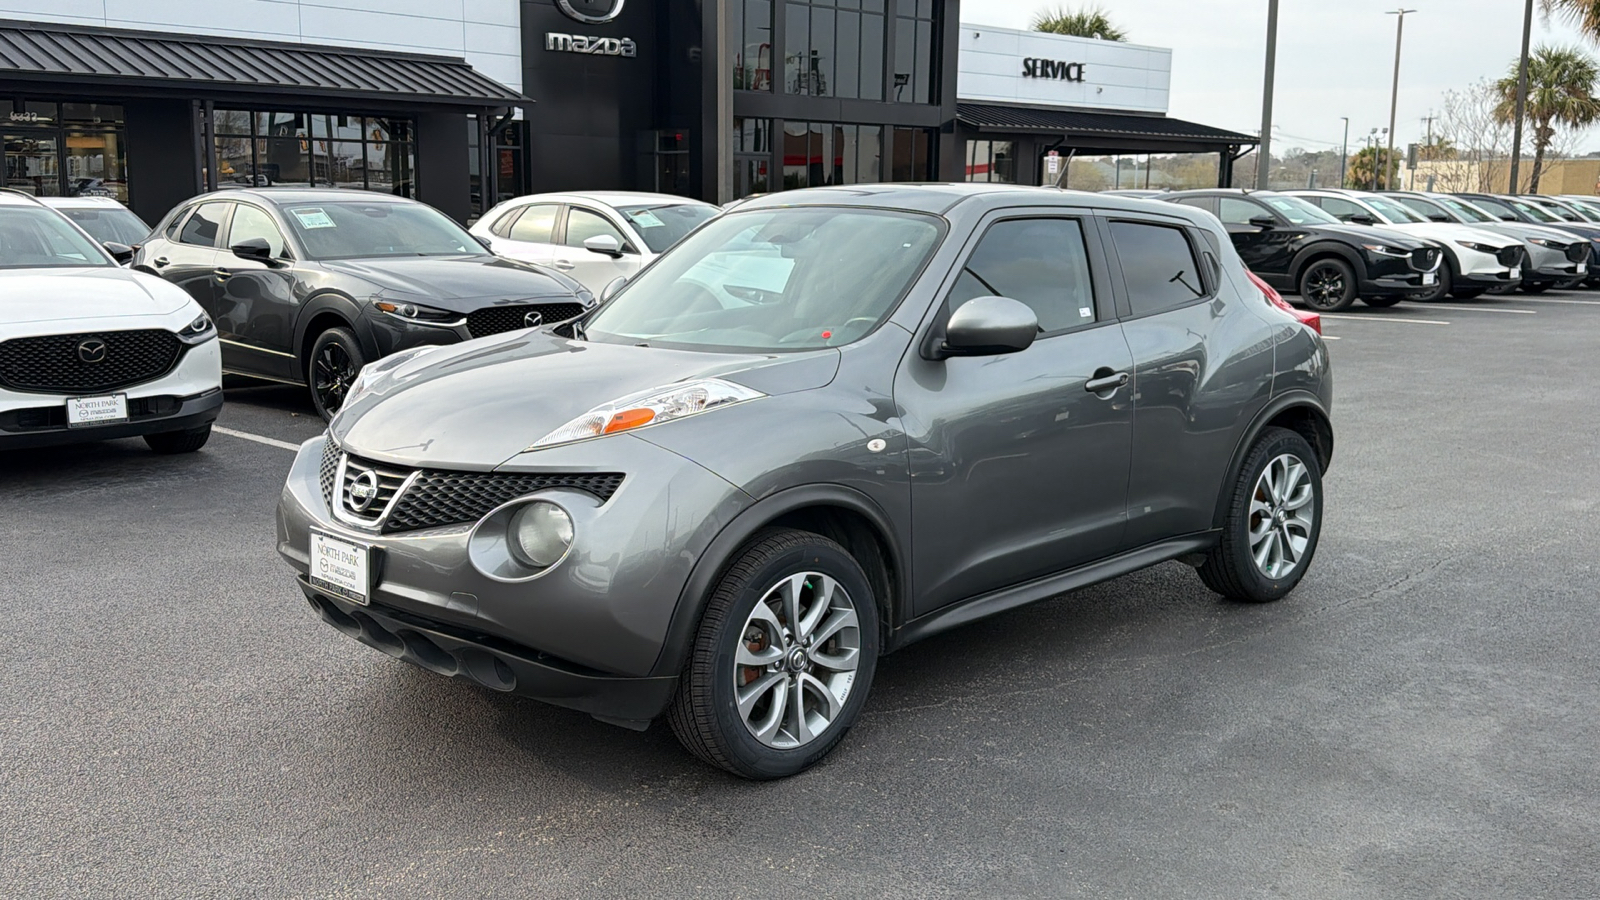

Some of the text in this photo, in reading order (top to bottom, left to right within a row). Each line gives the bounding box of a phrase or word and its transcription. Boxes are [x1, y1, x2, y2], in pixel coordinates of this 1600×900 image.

[1022, 57, 1087, 83] SERVICE
[75, 399, 119, 410] NORTH PARK
[317, 543, 359, 567] NORTH PARK
